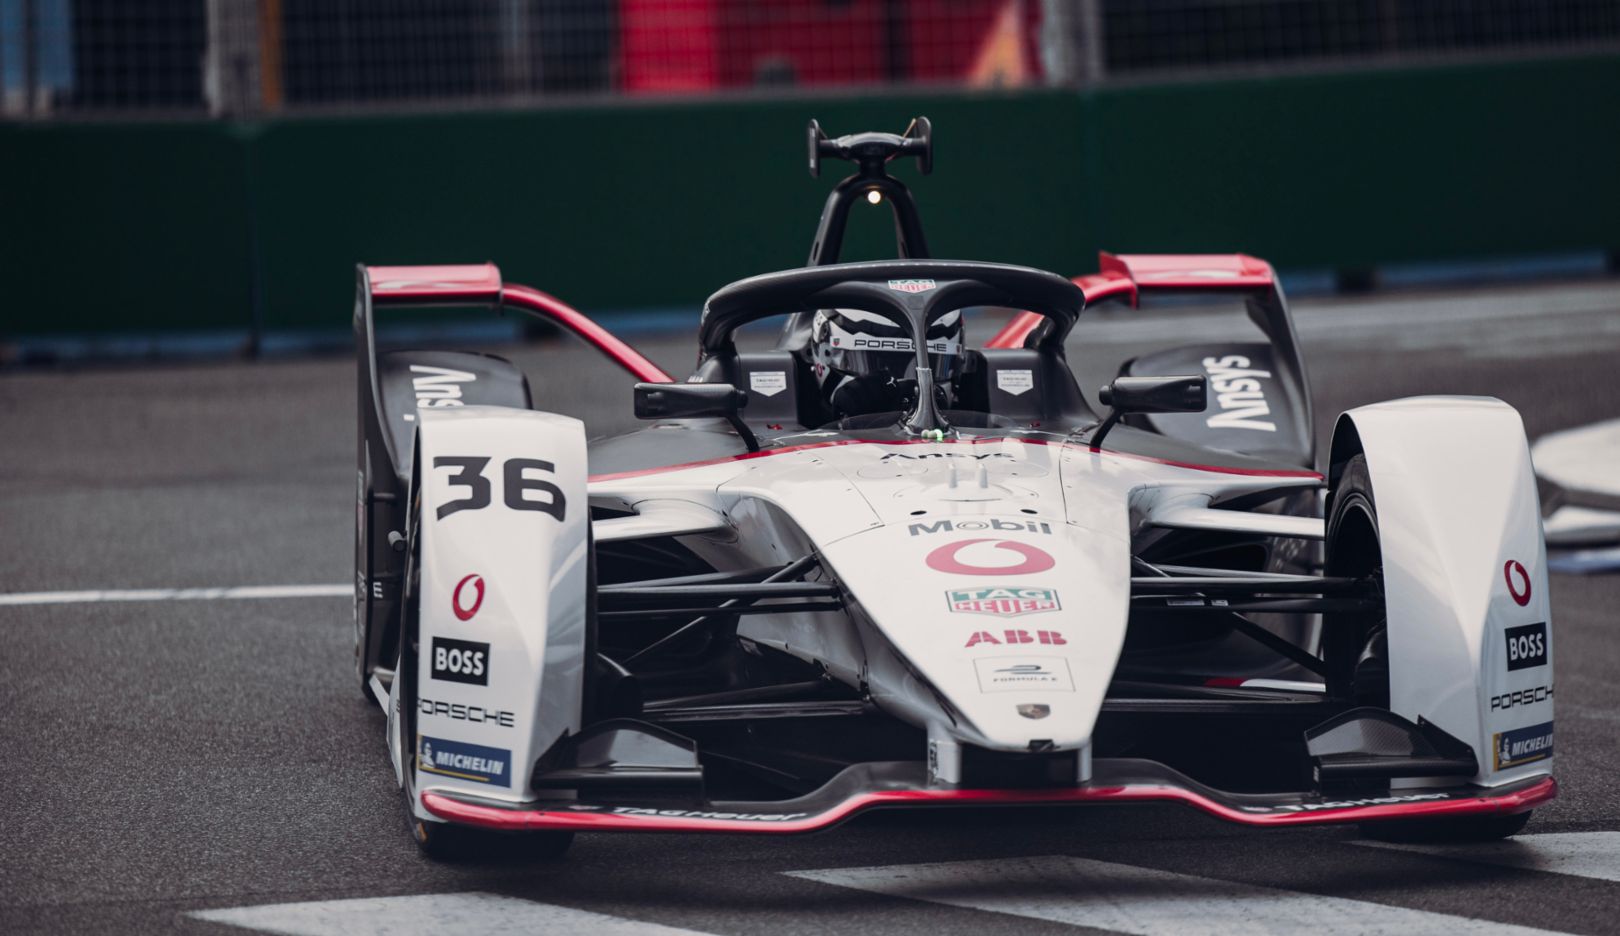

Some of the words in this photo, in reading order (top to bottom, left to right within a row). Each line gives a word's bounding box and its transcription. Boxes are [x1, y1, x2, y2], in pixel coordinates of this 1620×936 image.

[855, 339, 946, 352] PORSHE
[408, 365, 477, 409] Ans
[1202, 355, 1276, 432] Ansys
[433, 456, 566, 522] 36
[908, 519, 1052, 536] Mobil
[952, 599, 1056, 614] HEUER
[955, 588, 1048, 600] TAG
[964, 630, 1067, 647] ABB
[1509, 633, 1544, 661] BOSS
[435, 646, 484, 676] BOSS
[1491, 685, 1553, 712] PORSCH
[436, 751, 504, 775] MICHELIN
